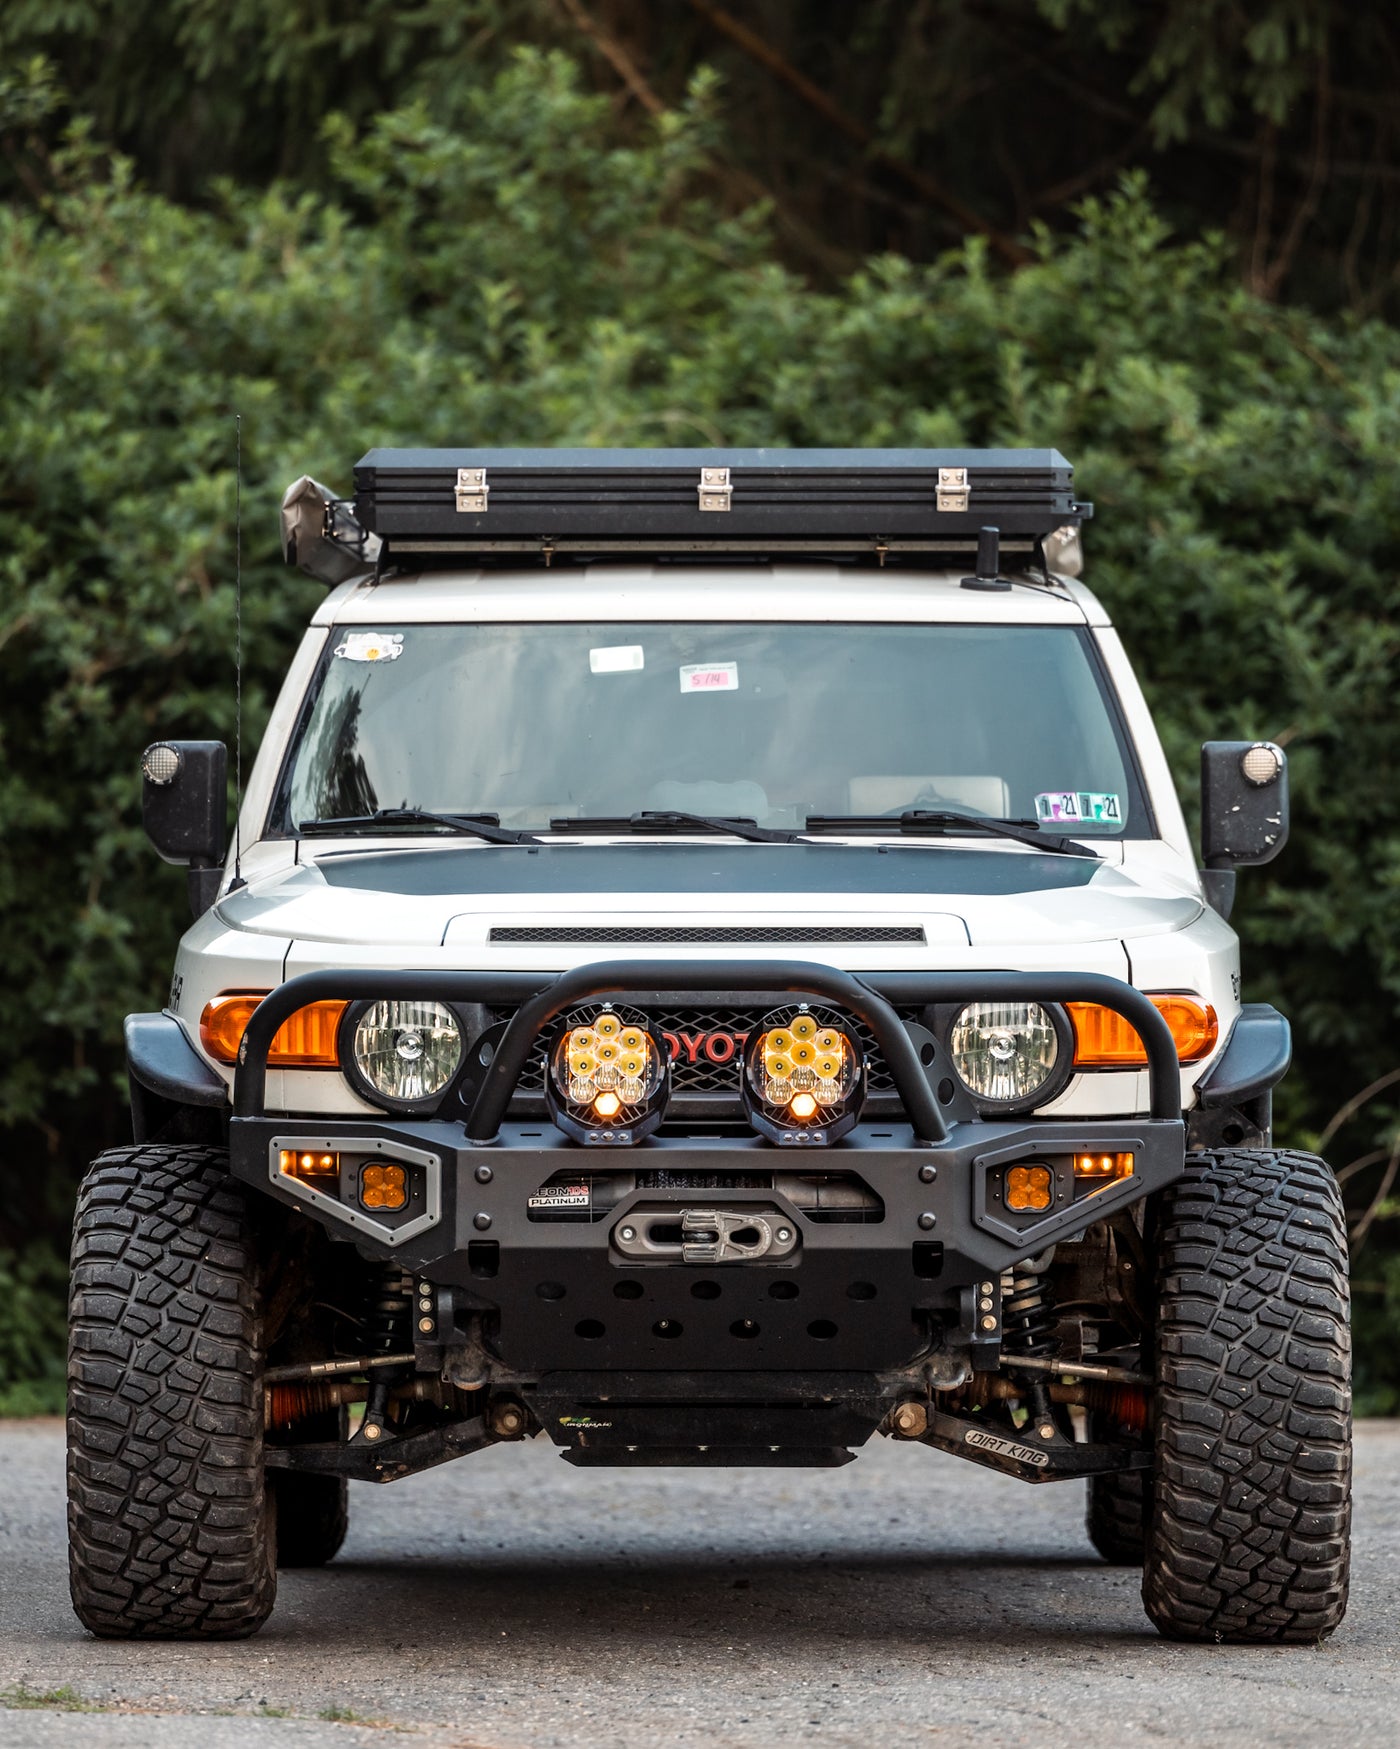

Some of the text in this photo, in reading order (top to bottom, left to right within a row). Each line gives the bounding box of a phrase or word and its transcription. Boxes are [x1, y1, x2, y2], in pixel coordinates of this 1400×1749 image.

[1062, 795, 1077, 815] 21
[1105, 797, 1119, 818] 21
[531, 1197, 586, 1206] PLATINUM
[969, 1432, 1045, 1464] DIRT KING
